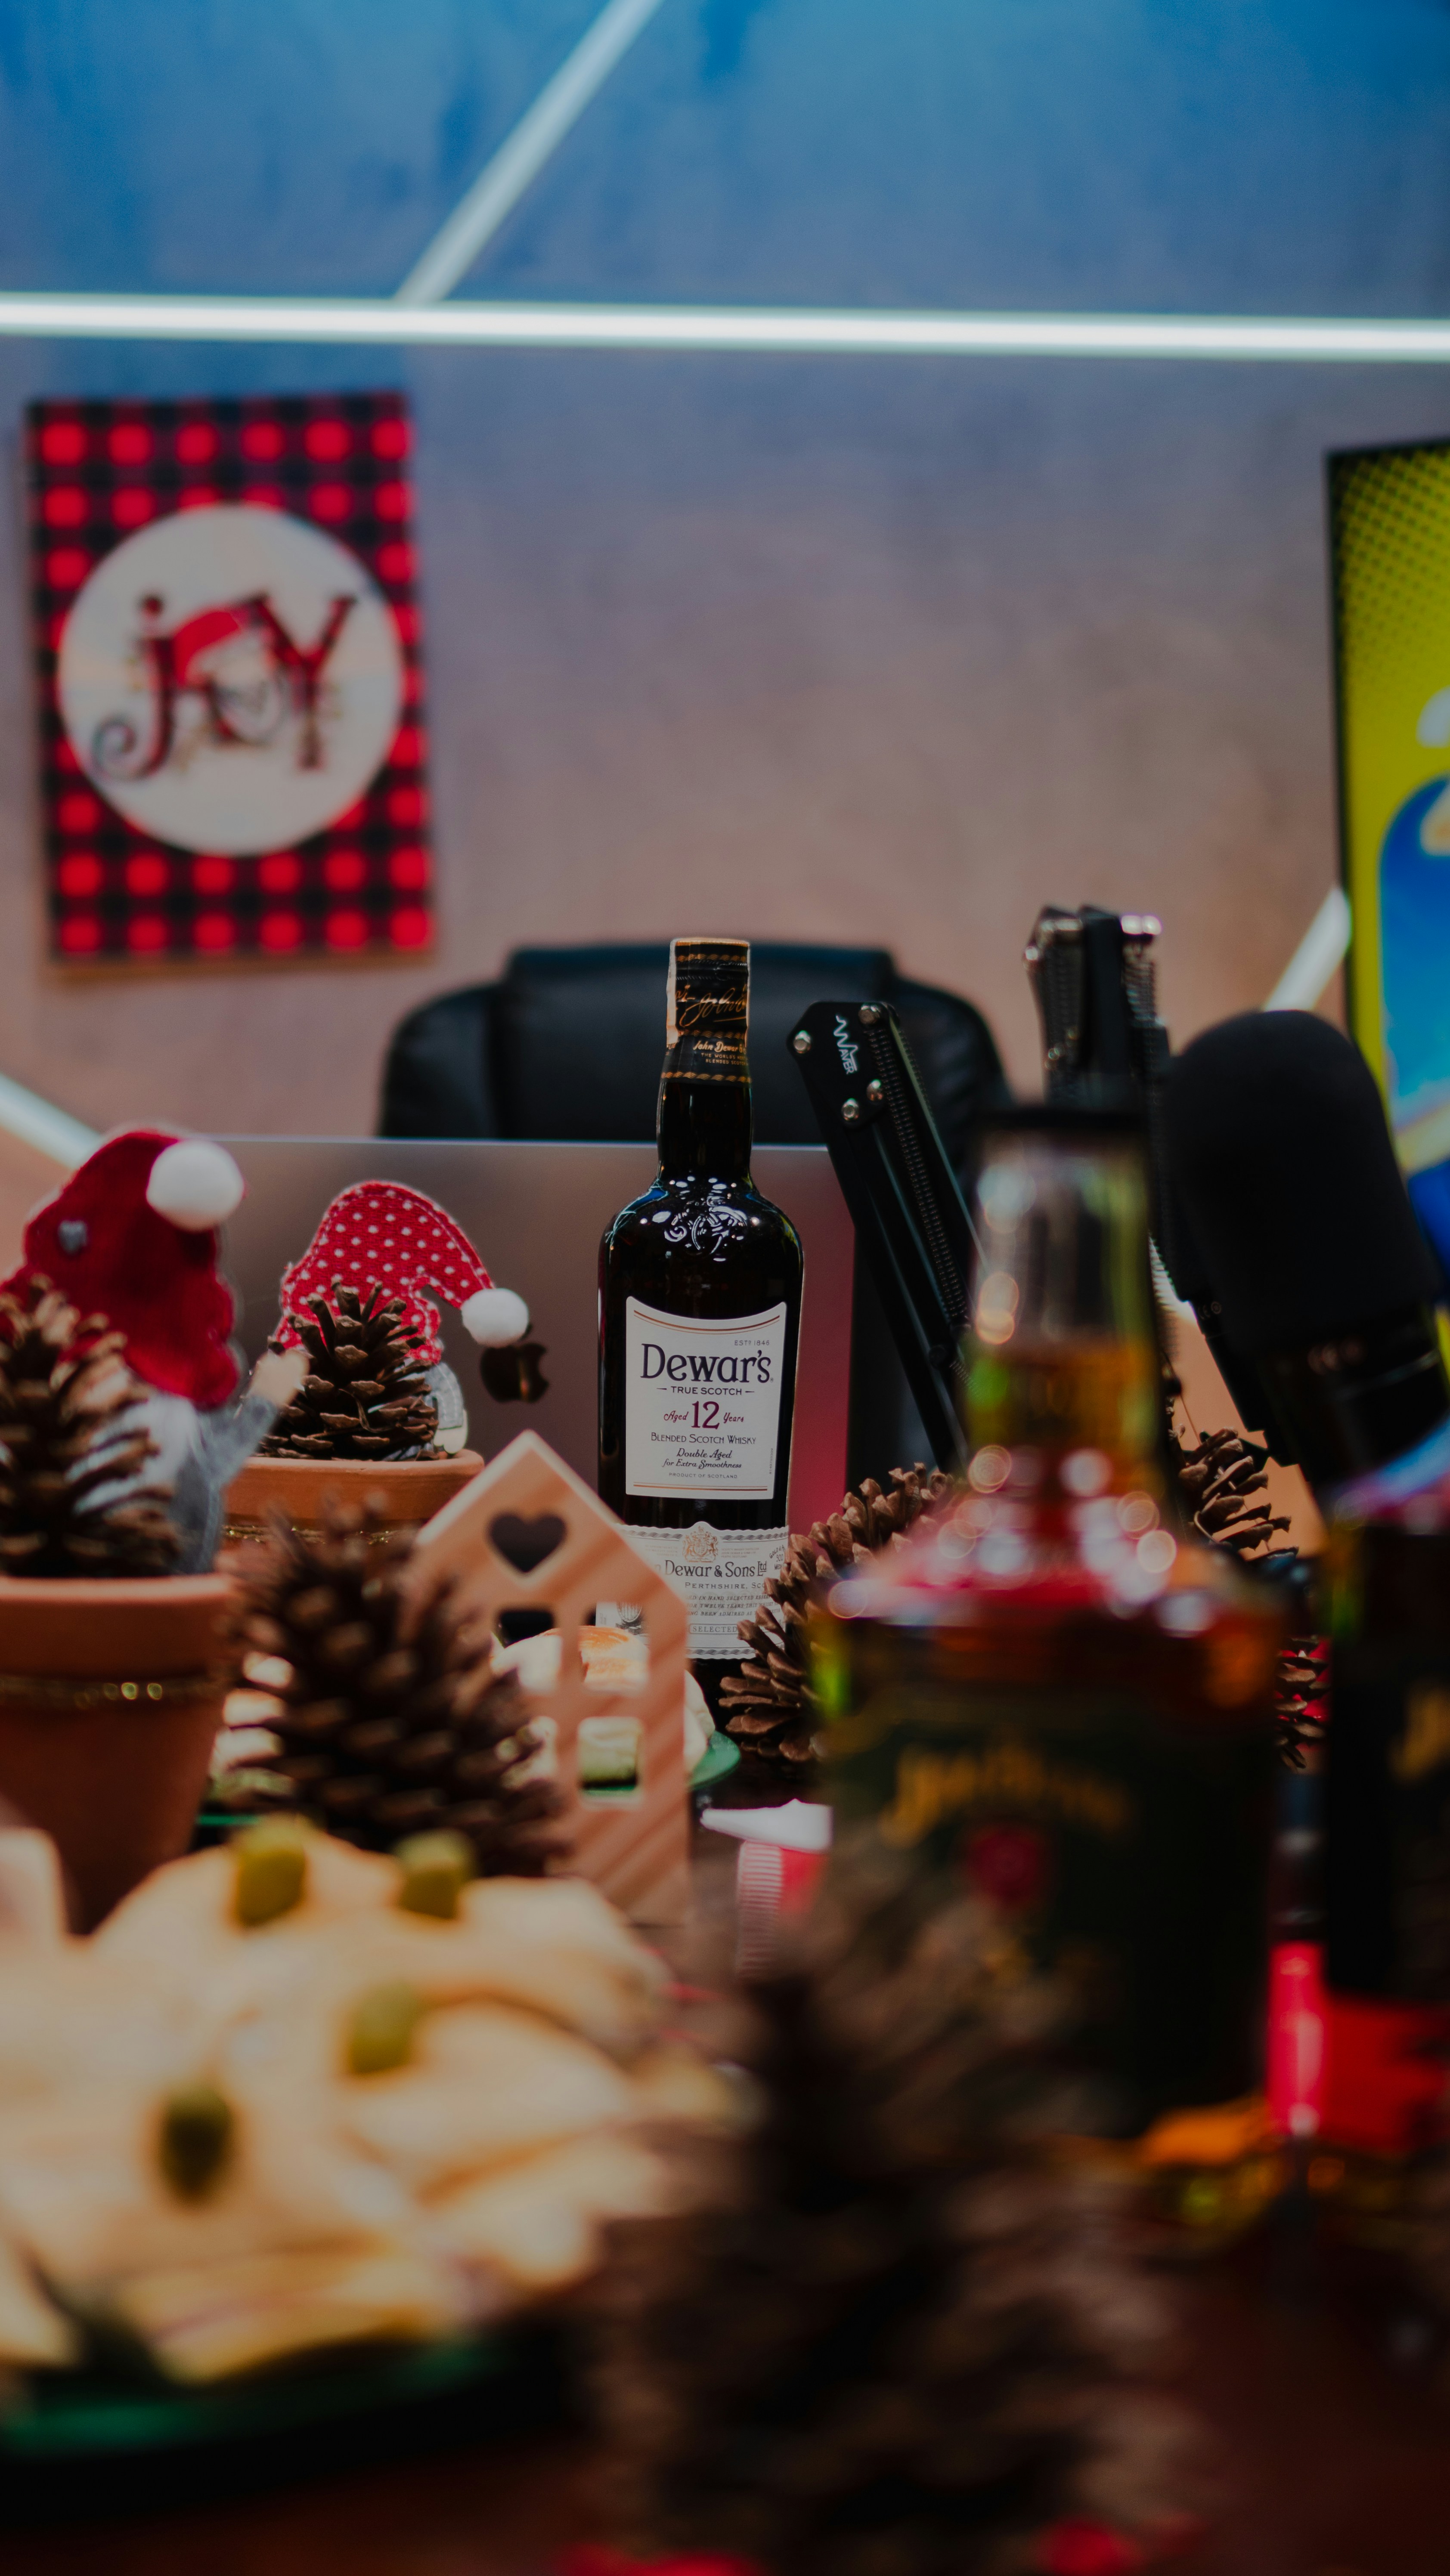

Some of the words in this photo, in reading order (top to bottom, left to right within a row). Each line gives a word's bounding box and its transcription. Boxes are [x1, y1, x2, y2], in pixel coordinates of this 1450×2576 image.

[714, 1041, 738, 1053] Dewar
[640, 1343, 771, 1383] Dewar's
[671, 1386, 698, 1395] TRUE
[663, 1410, 689, 1423] Aged
[691, 1401, 720, 1430] 12
[723, 1412, 744, 1424] Years
[676, 1447, 707, 1458] Double
[709, 1449, 733, 1460] Aged
[662, 1458, 674, 1467] for
[675, 1459, 697, 1467] Extra
[697, 1460, 742, 1469] Smoothness
[769, 1547, 781, 1559] GOLD
[664, 1560, 712, 1577] Dewar
[714, 1565, 723, 1578] &
[725, 1562, 755, 1577] Sons
[757, 1561, 767, 1577] Ltd
